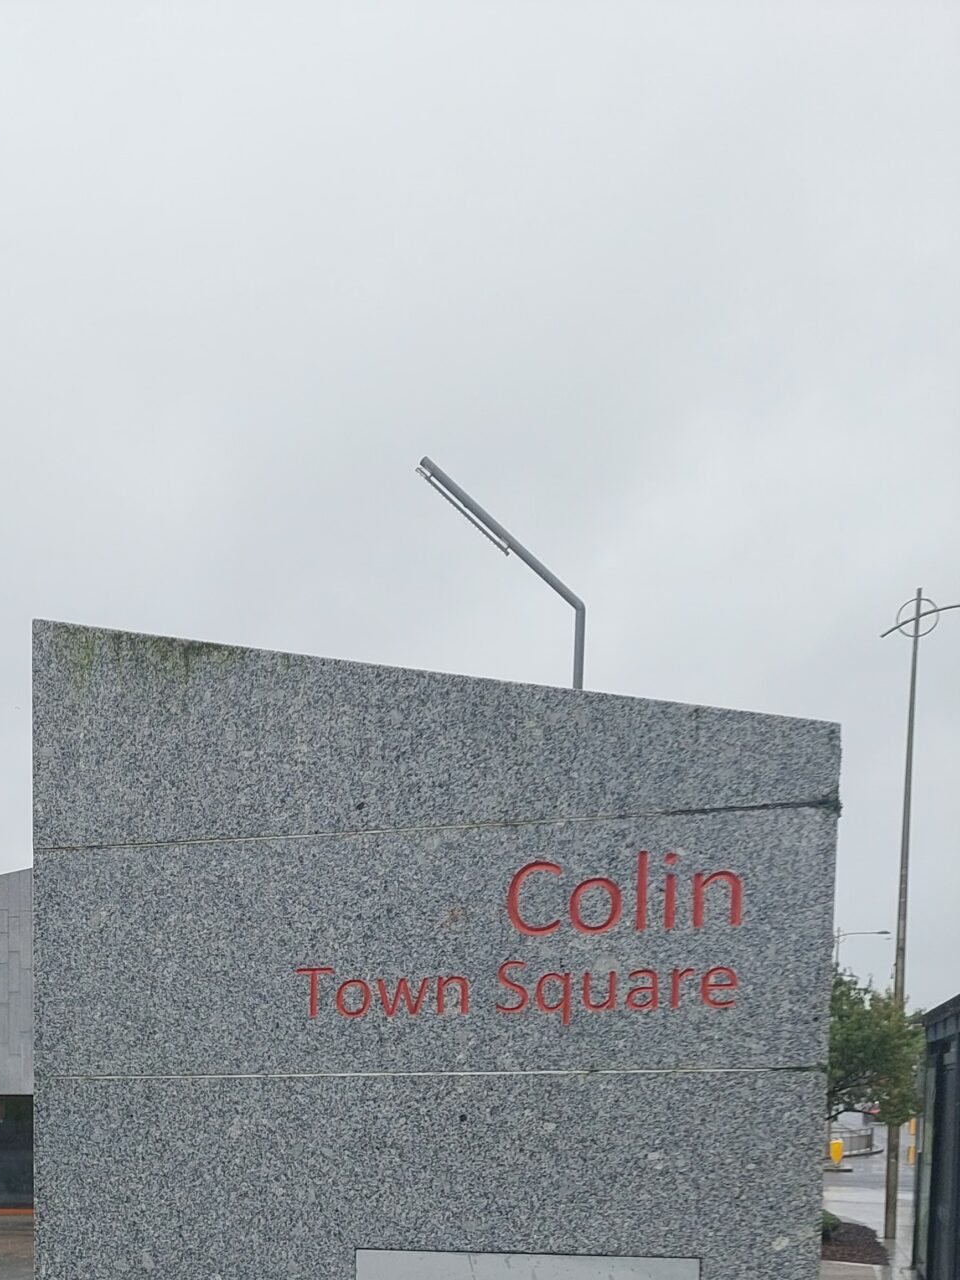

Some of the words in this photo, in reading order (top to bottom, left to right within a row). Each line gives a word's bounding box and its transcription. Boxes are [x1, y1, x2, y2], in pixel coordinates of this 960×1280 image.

[506, 850, 744, 937] Colin
[295, 966, 471, 1020] Town
[496, 960, 739, 1026] Square
